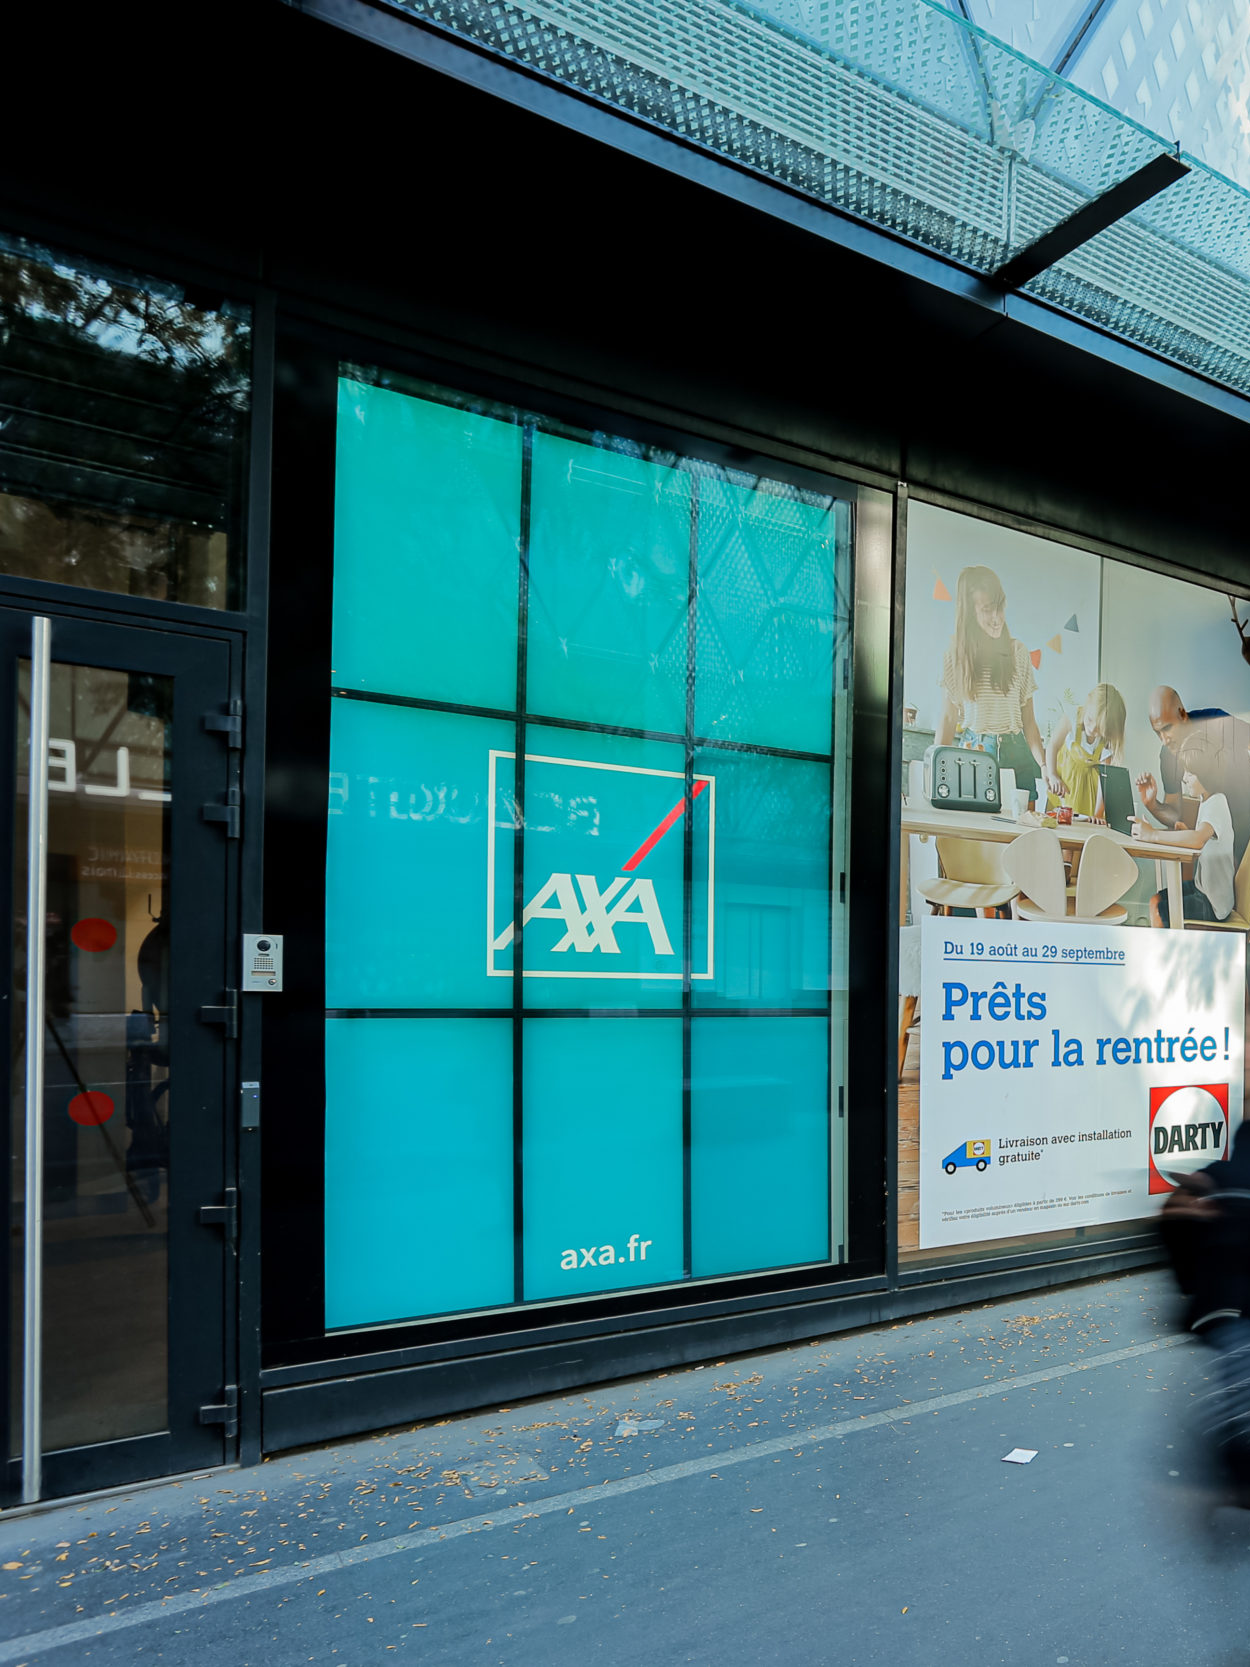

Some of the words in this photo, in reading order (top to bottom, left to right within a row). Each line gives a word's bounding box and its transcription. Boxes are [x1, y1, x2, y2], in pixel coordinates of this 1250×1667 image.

[492, 872, 675, 955] AXA
[943, 941, 963, 955] Du
[970, 942, 984, 956] 19
[988, 944, 1018, 957] août
[1022, 946, 1038, 957] au
[1042, 945, 1058, 958] 29
[1061, 946, 1126, 961] septembre
[942, 981, 1047, 1021] Prêts
[942, 1039, 1040, 1080] pour
[1051, 1029, 1084, 1067] la
[998, 1136, 1049, 1150] Livraison
[1051, 1134, 1076, 1145] avec
[1077, 1128, 1132, 1143] installation
[1154, 1120, 1224, 1155] DARTY
[560, 1233, 653, 1270] axa.fr
